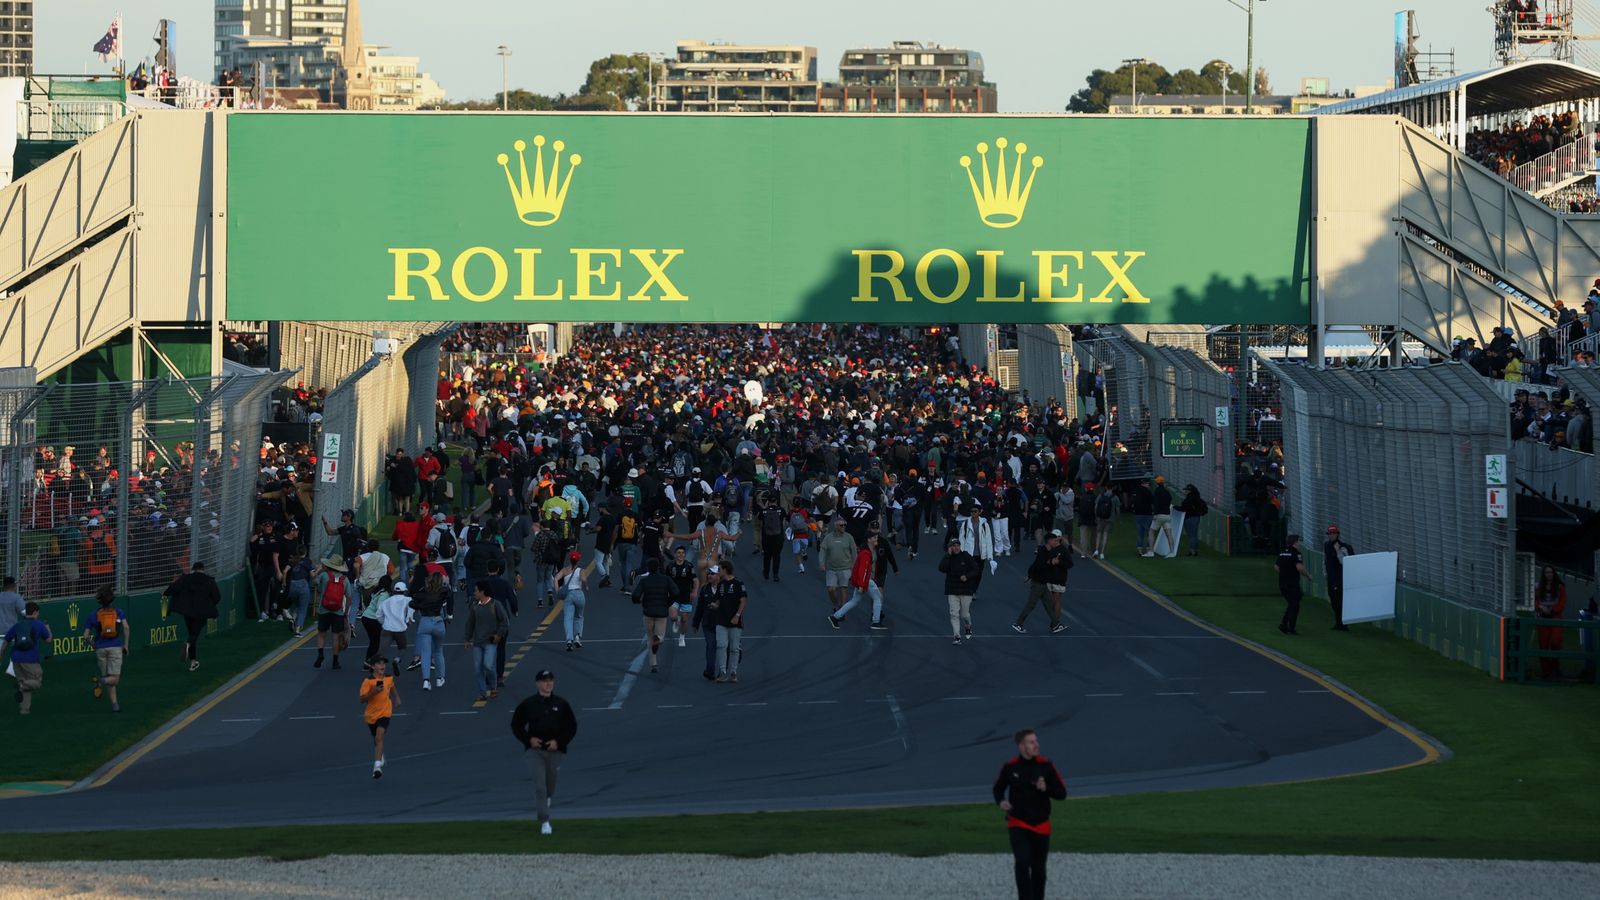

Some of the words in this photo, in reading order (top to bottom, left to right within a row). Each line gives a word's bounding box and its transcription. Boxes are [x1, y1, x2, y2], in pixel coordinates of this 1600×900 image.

[387, 246, 689, 301] ROLEX
[851, 248, 1151, 304] ROLEX
[1170, 438, 1196, 446] ROLEX
[150, 625, 177, 645] ROLEX
